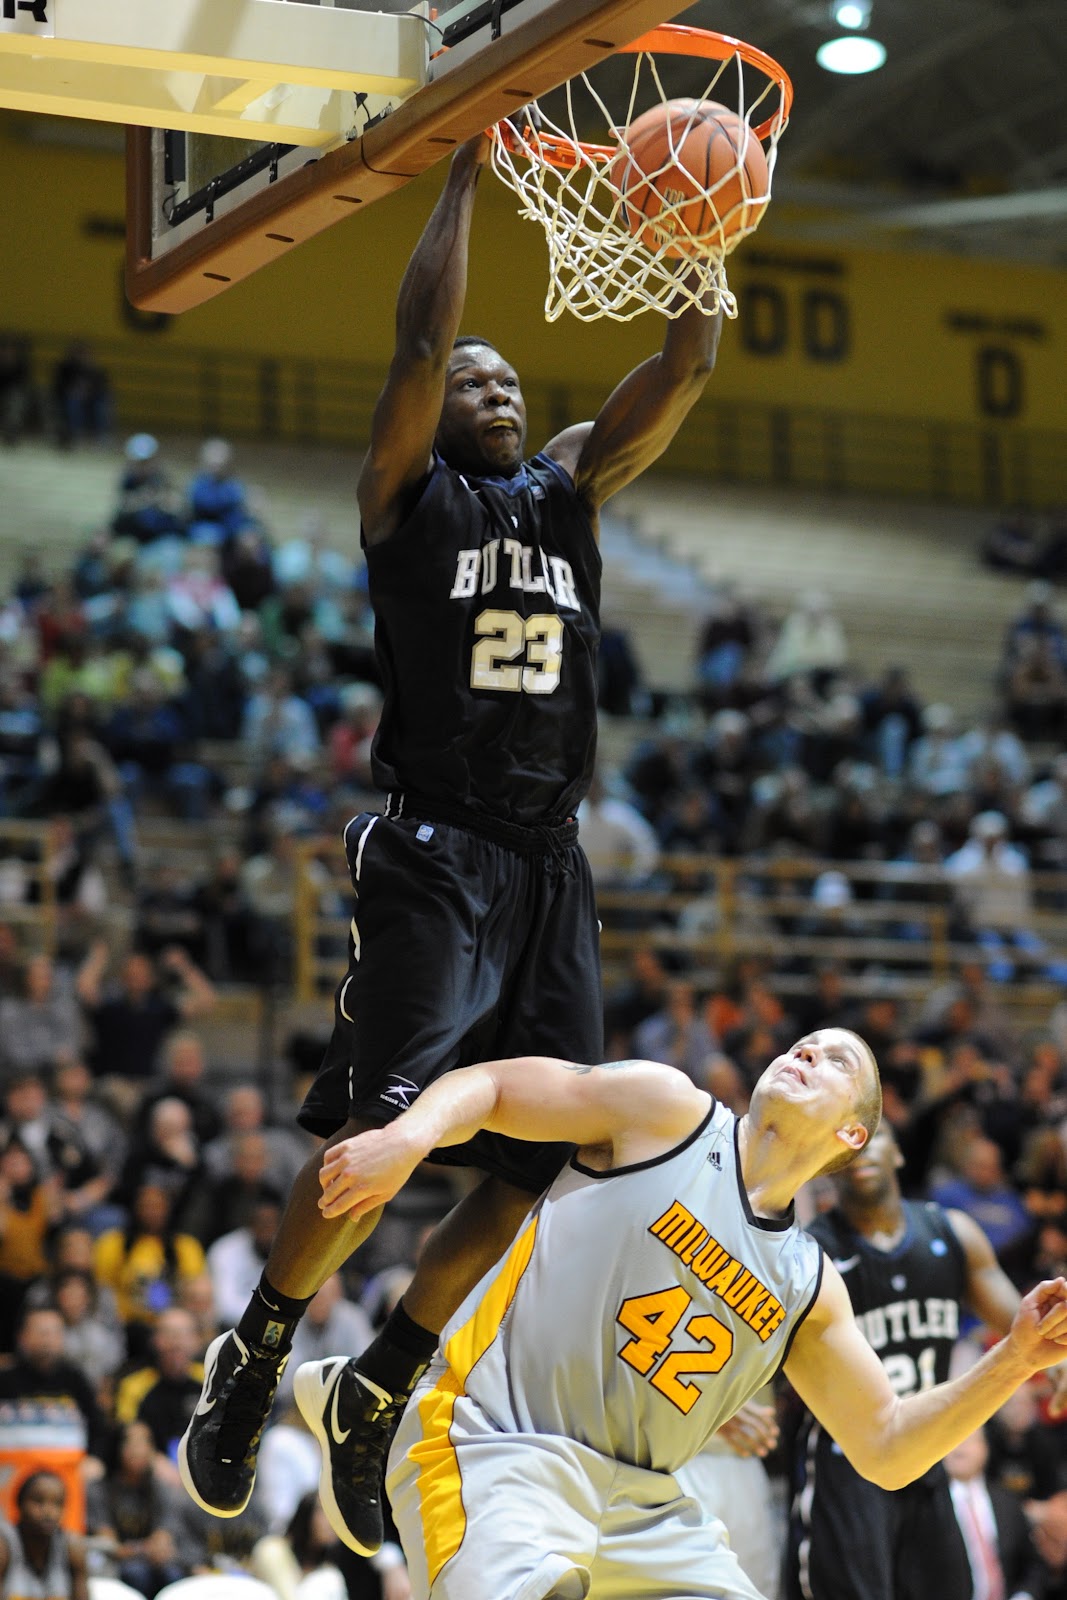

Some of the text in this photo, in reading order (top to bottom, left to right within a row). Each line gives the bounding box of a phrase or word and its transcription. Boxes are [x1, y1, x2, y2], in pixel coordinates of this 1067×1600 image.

[470, 608, 565, 695] 23
[647, 1199, 787, 1343] MILWAUKEE
[616, 1285, 734, 1416] 42
[882, 1347, 936, 1399] 21
